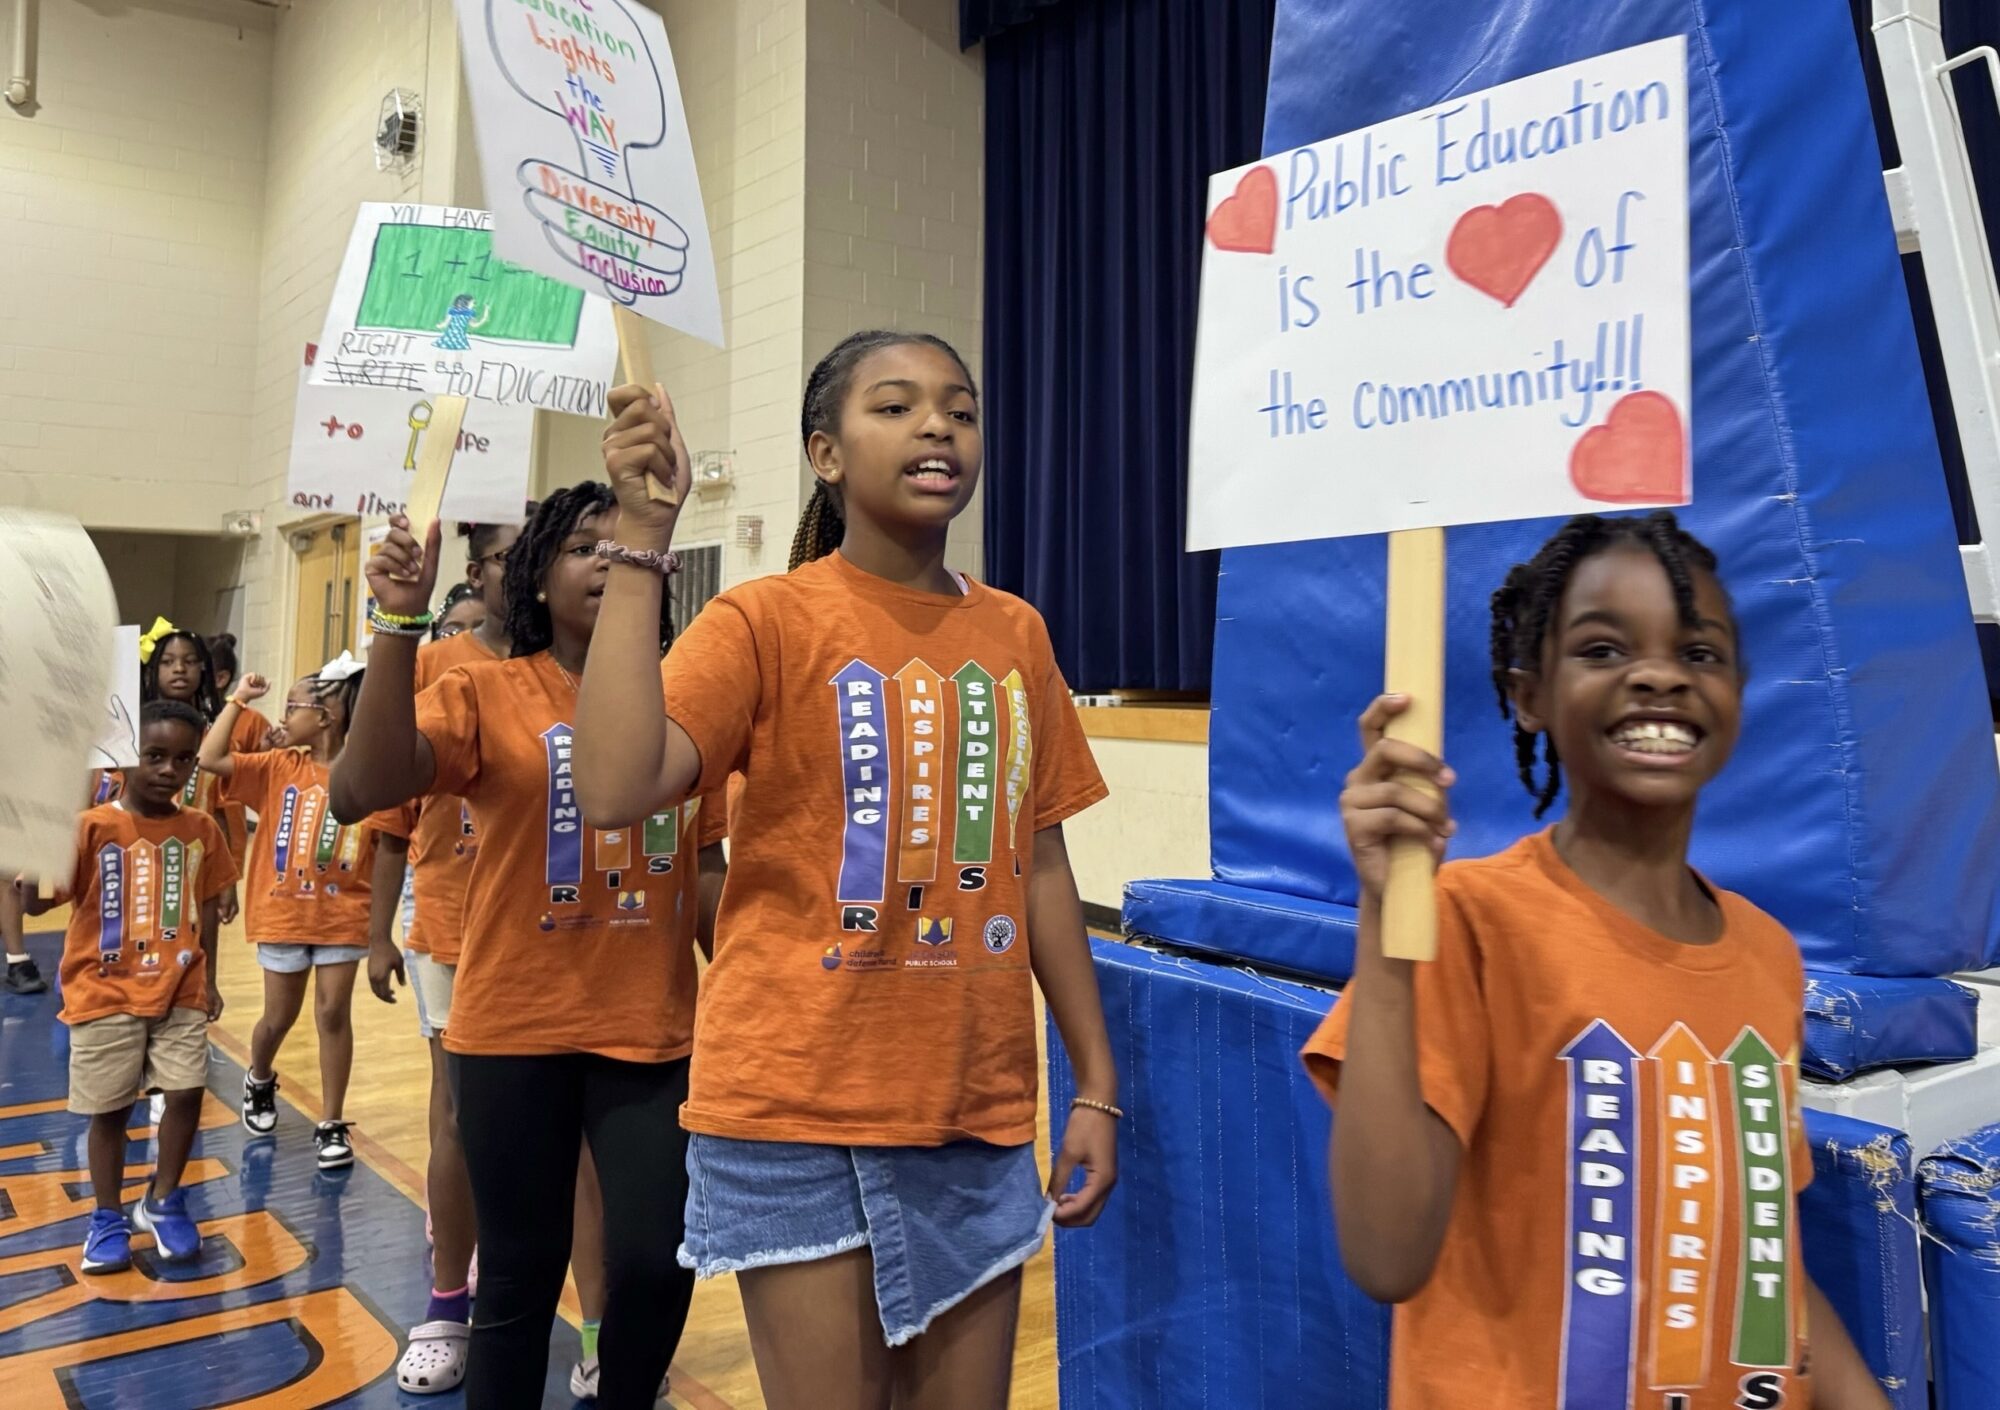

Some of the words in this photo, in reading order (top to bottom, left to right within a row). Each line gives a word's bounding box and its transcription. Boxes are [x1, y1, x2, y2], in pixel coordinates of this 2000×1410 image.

[526, 13, 616, 84] Lights
[565, 72, 605, 113] the
[554, 90, 619, 151] WAY
[1284, 132, 1412, 230] Public
[1430, 78, 1669, 187] Education
[538, 165, 656, 248] Diversity
[578, 243, 668, 294] Inclusion
[1277, 265, 1321, 333] is
[1345, 247, 1436, 315] the
[1573, 190, 1647, 288] of
[338, 331, 417, 356] RIGHT
[474, 360, 607, 416] EDUCATION
[1257, 368, 1328, 438] the
[1353, 313, 1646, 428] community!!!
[320, 415, 364, 439] to
[455, 428, 490, 452] ife
[554, 735, 577, 833] READING
[847, 680, 881, 825] READING
[910, 679, 934, 845] INSPIRES
[962, 681, 990, 821] STUDENT
[104, 853, 120, 919] READING
[165, 846, 180, 911] STUDENT
[1576, 1059, 1627, 1296] READING
[1665, 1061, 1710, 1329] INSPIRES
[1741, 1063, 1784, 1299] STUDENT
